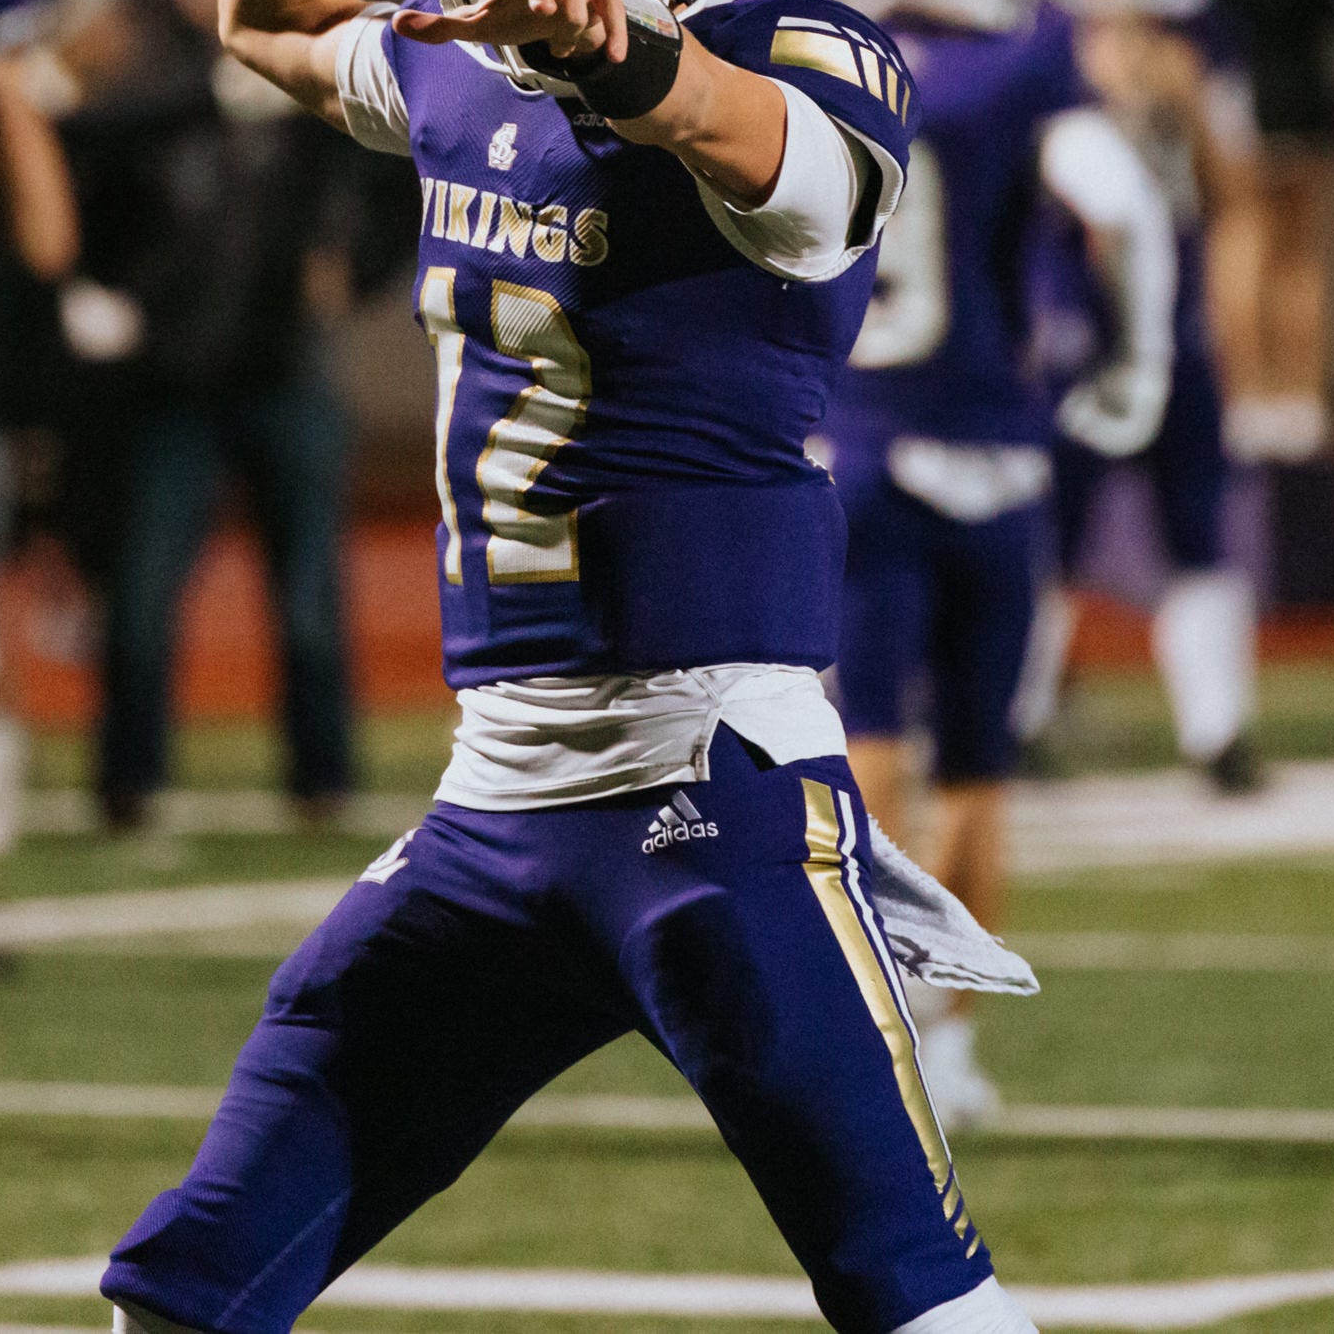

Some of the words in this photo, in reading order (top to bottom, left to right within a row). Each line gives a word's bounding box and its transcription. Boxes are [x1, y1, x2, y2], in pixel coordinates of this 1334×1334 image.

[420, 177, 609, 266] VIKINGS
[418, 266, 591, 585] 12
[641, 821, 719, 854] adidas
